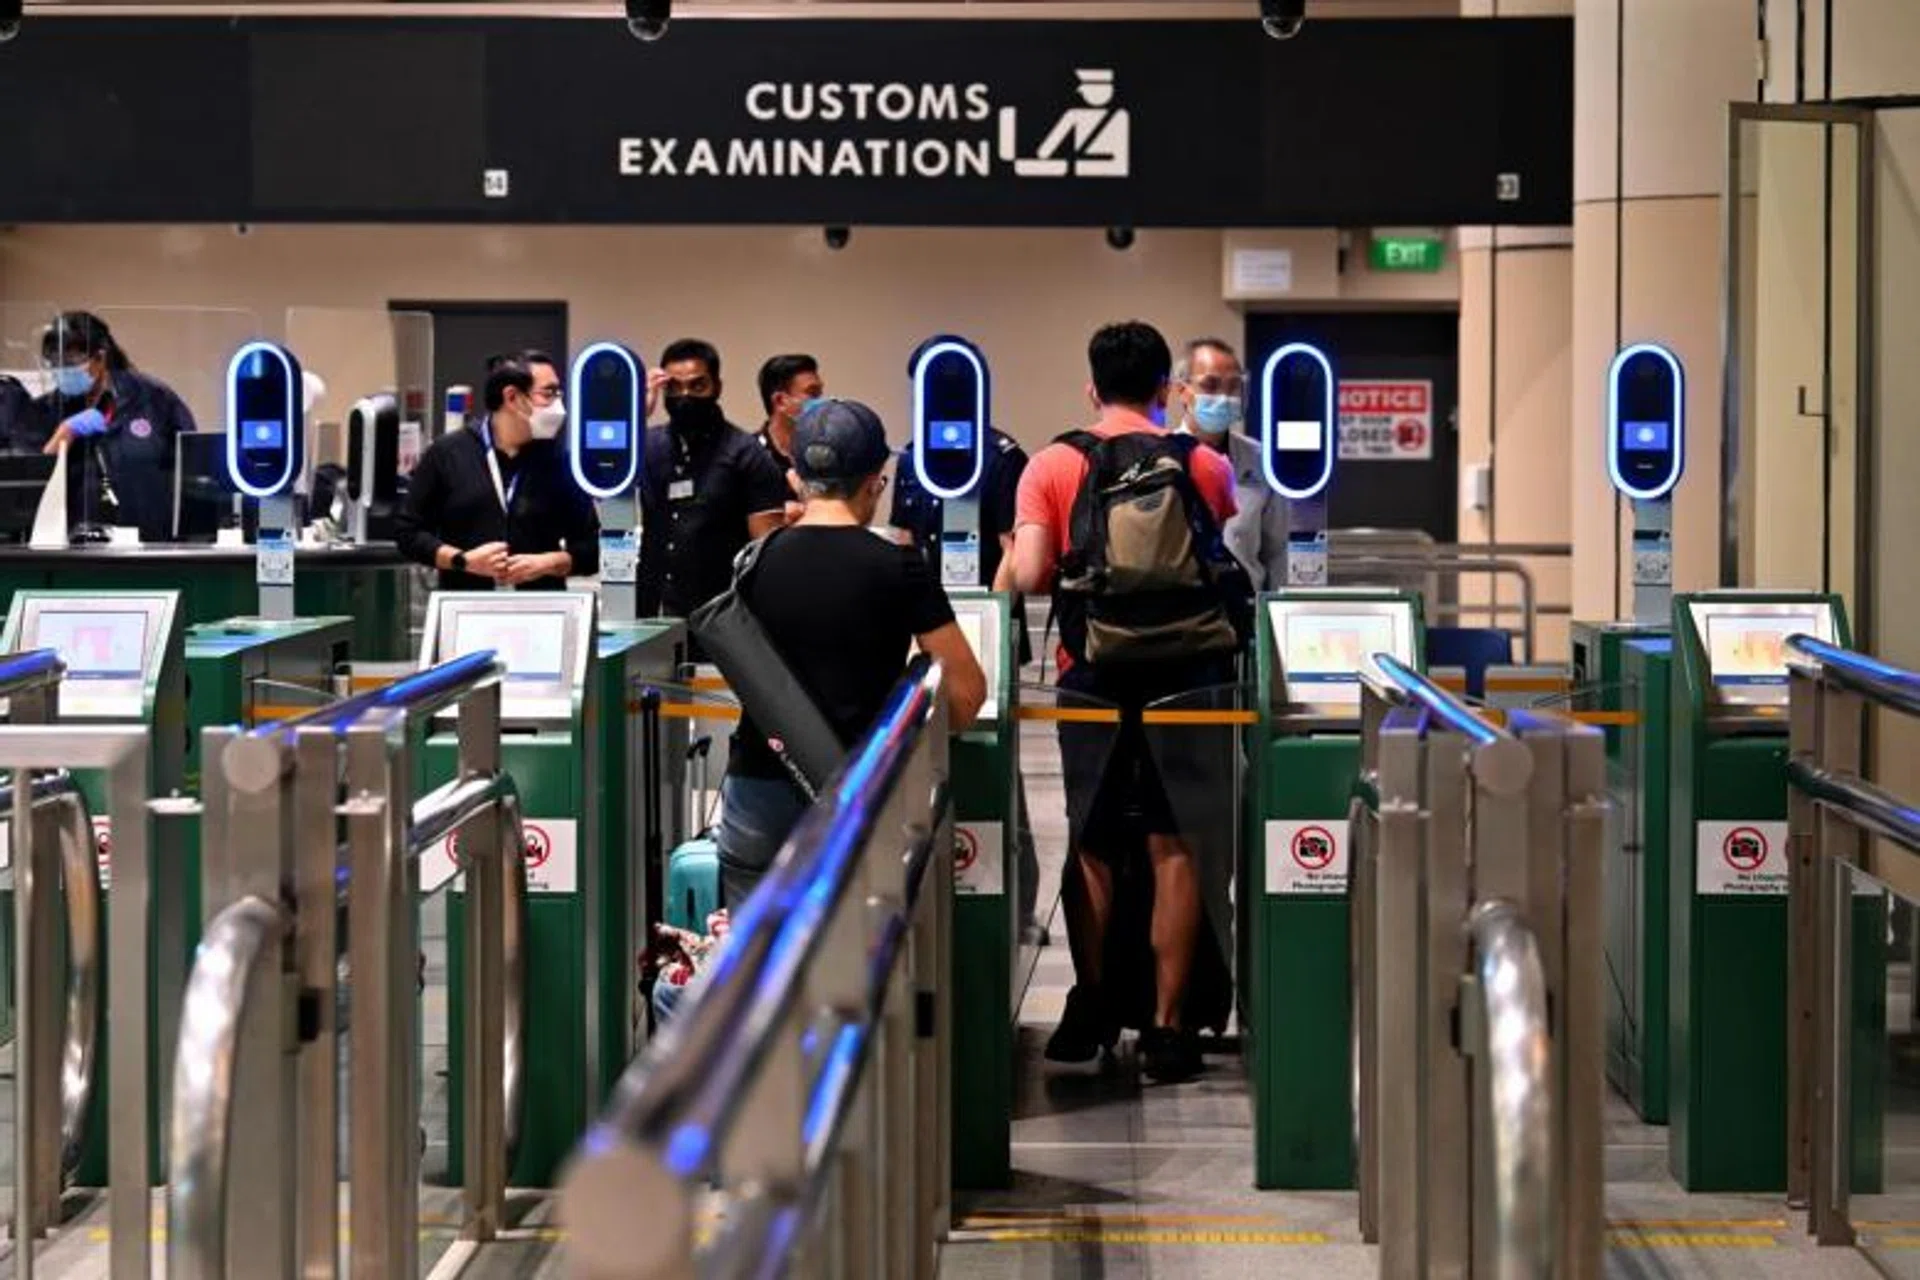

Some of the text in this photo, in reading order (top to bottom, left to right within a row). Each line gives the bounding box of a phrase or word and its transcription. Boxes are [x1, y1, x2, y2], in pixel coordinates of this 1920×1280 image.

[746, 82, 990, 120] CUSTOMS
[619, 138, 990, 176] EXAMINATION
[1385, 242, 1426, 265] EXIT
